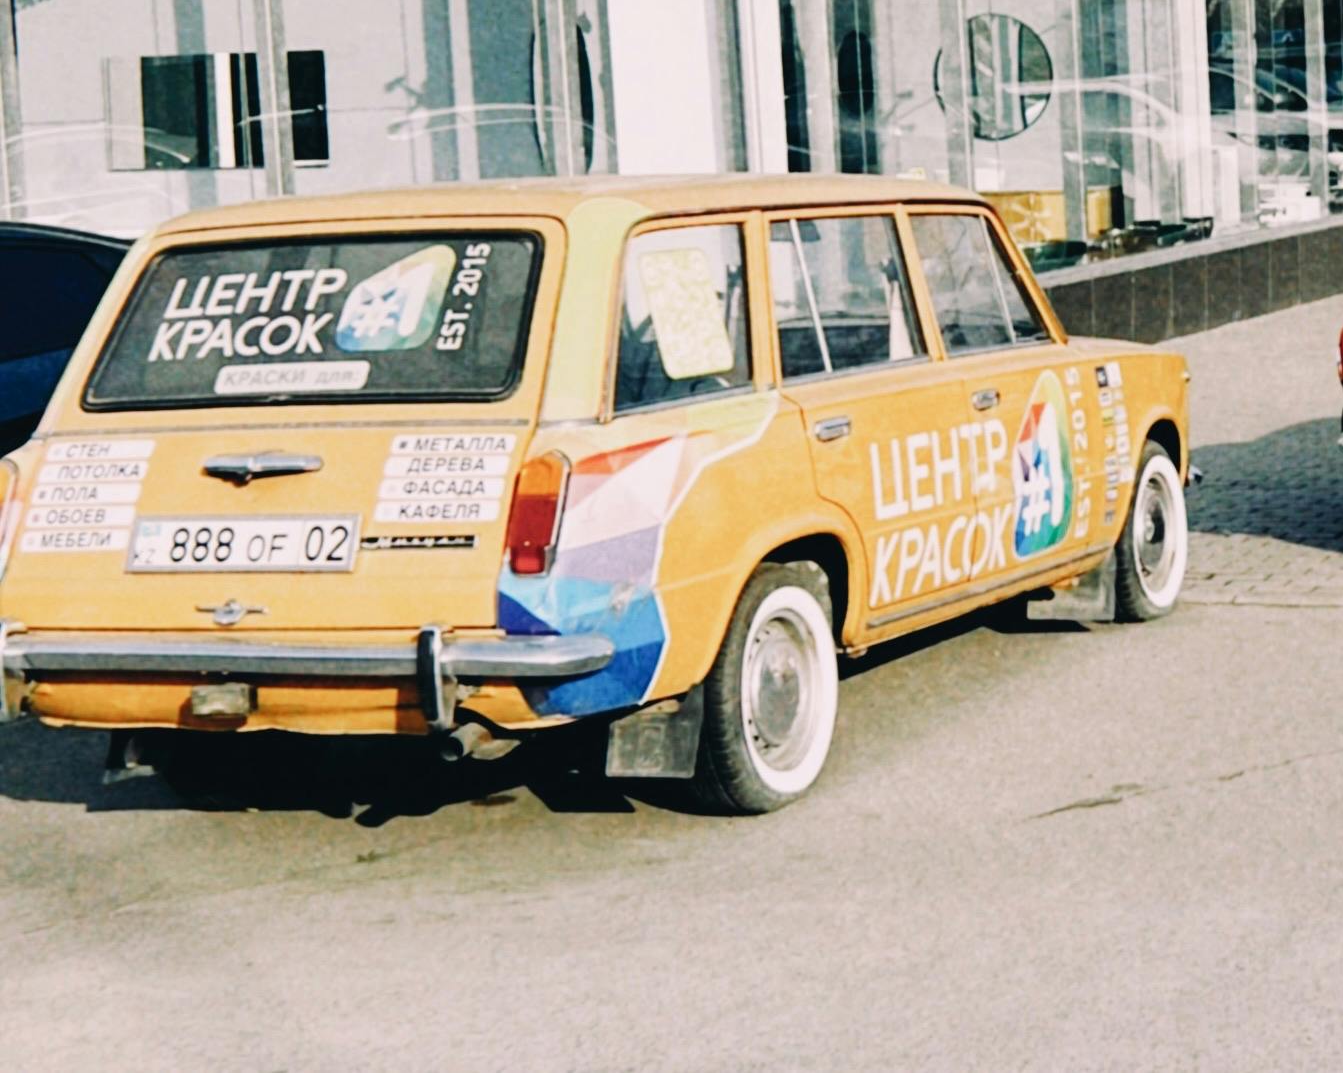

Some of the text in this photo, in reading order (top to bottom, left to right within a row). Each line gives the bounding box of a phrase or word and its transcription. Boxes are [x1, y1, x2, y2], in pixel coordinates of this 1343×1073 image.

[163, 268, 348, 320] ЦЕНТР
[437, 242, 492, 351] EST. 2015
[148, 312, 334, 363] КРАСОК
[223, 369, 306, 387] КРАСКИ
[1064, 366, 1089, 451] 2015
[65, 443, 111, 458] СТЕН
[413, 437, 507, 451] МЕТАЛЛА
[57, 464, 140, 481] ПОТОЛКА
[406, 457, 485, 473] ДЕРЕВА
[869, 418, 1008, 521] ЦЕНТР
[50, 486, 97, 502] ПОЛА
[402, 479, 486, 495] ФАСАДА
[45, 508, 106, 524] ОБОЕВ
[398, 503, 481, 519] КАФЕЛЯ
[40, 532, 112, 547] МЕБЕЛИ
[169, 525, 349, 563] 888 OF 02
[868, 502, 1013, 608] КРАСОК
